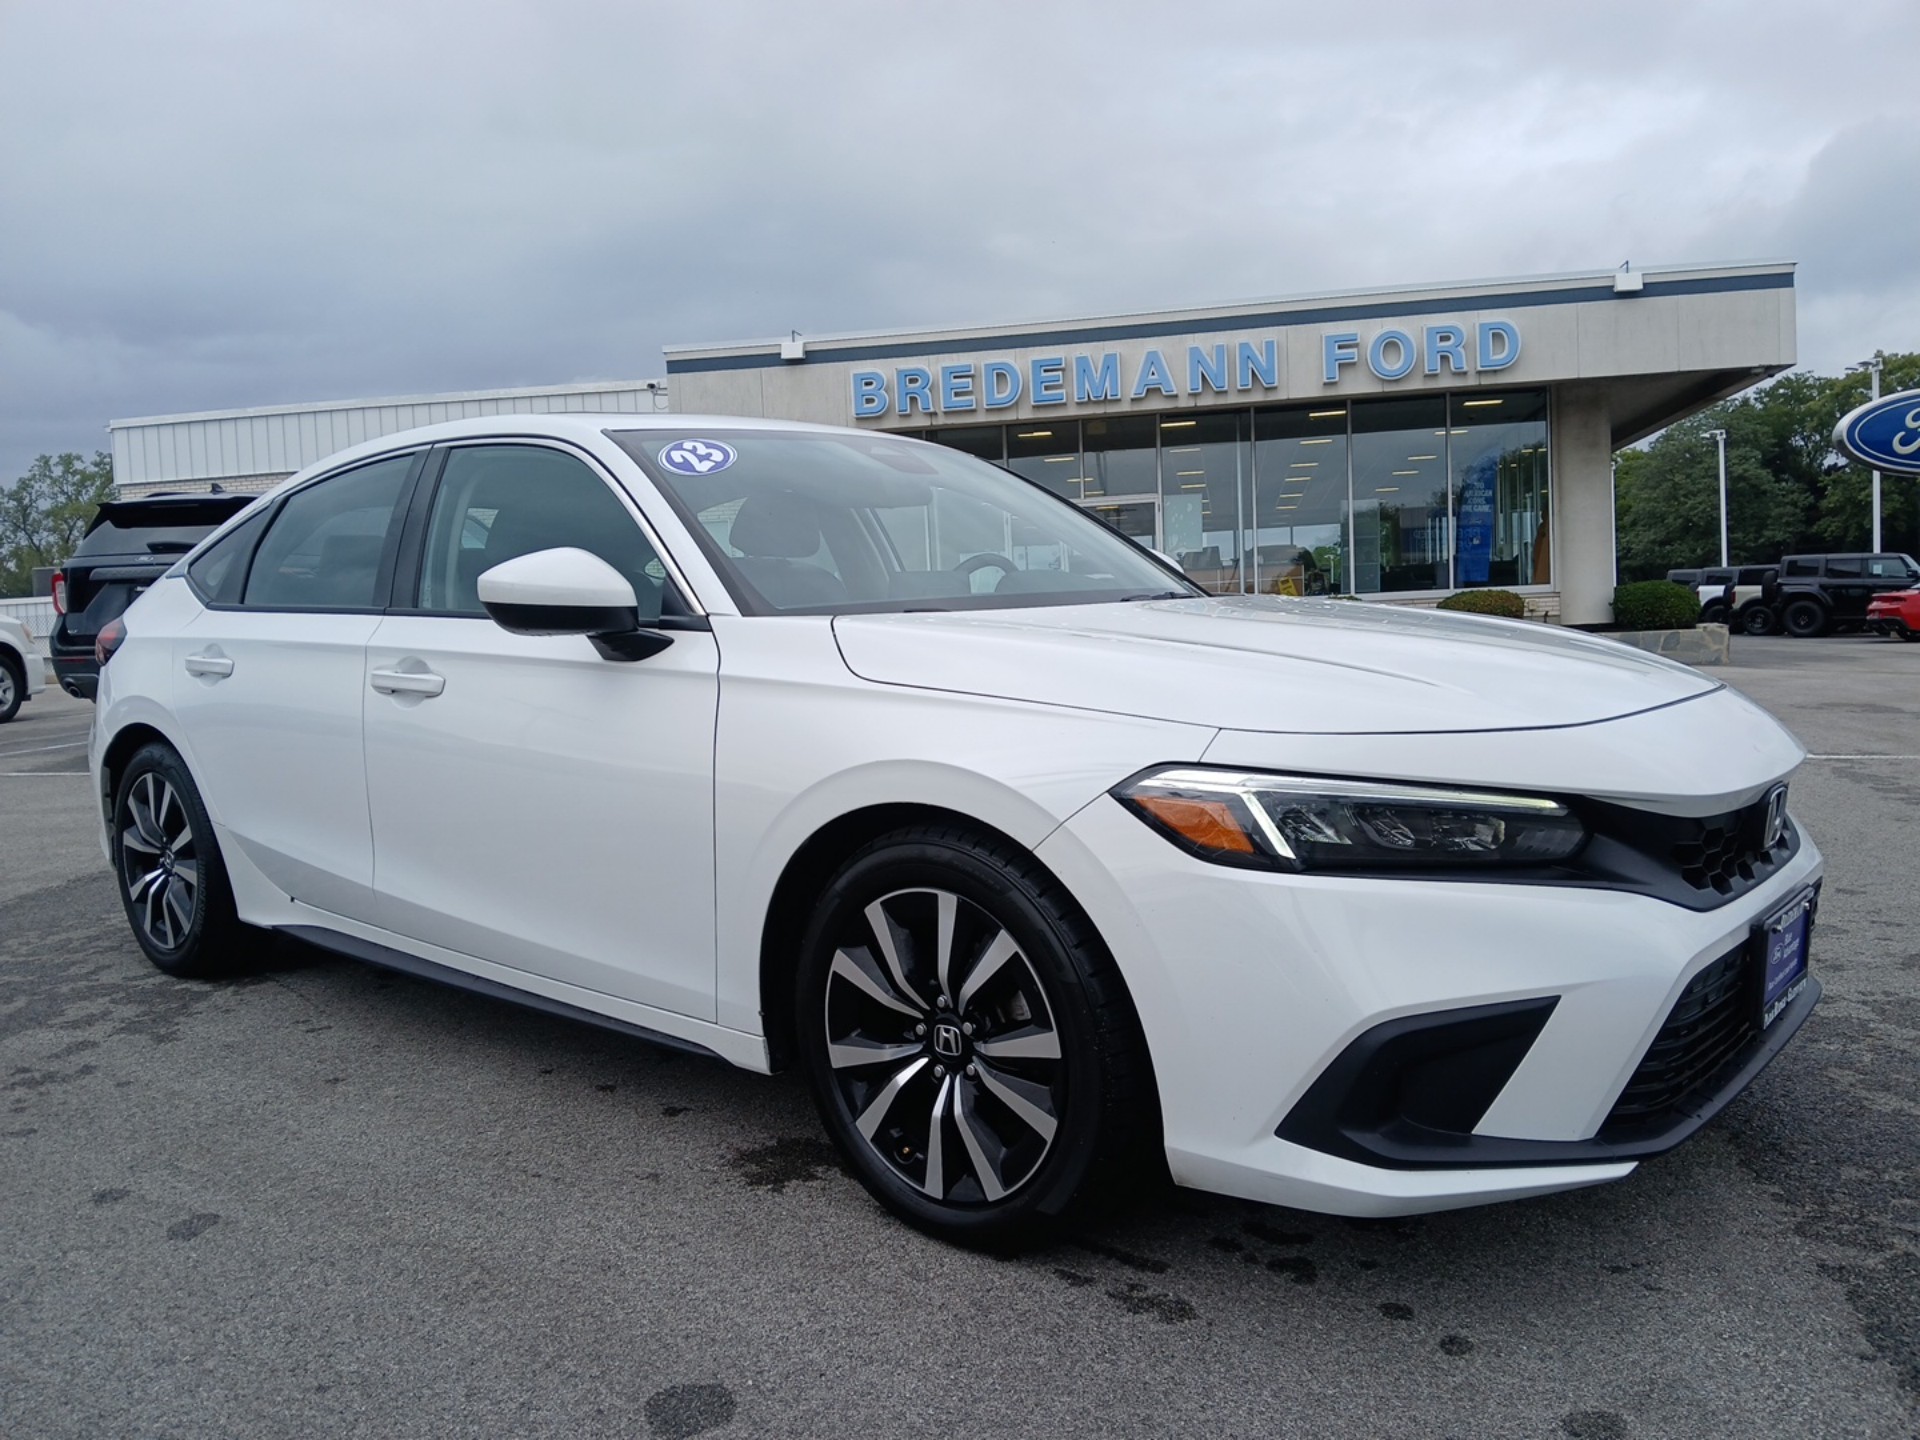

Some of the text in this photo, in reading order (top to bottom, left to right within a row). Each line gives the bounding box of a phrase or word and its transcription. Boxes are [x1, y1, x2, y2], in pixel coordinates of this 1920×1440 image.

[851, 319, 1521, 419] BREDEMANN FORD
[670, 441, 725, 473] 23
